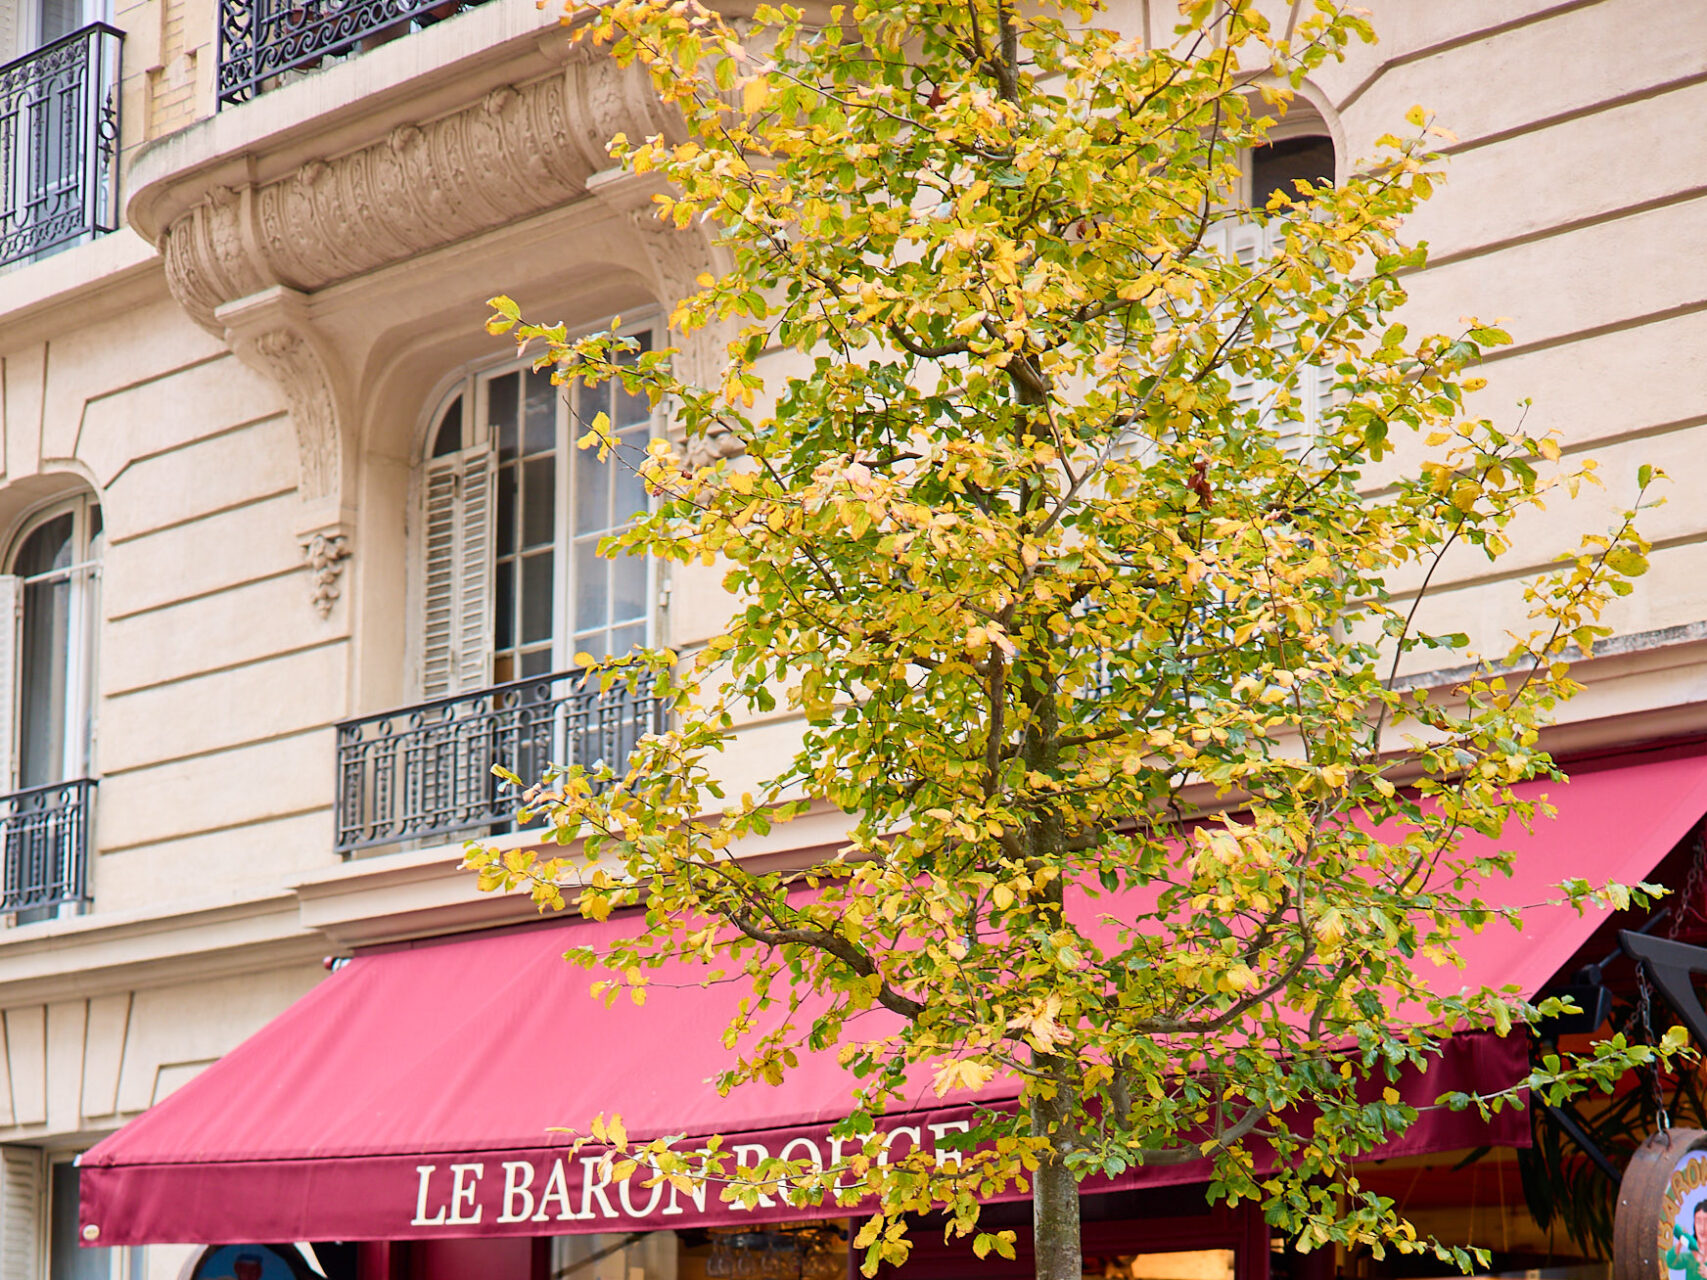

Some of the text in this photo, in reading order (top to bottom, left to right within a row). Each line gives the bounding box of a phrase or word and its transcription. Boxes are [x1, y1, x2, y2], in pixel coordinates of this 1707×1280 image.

[411, 1163, 484, 1226] LE
[497, 1147, 711, 1223] BARON
[1657, 1155, 1707, 1251] BARO
